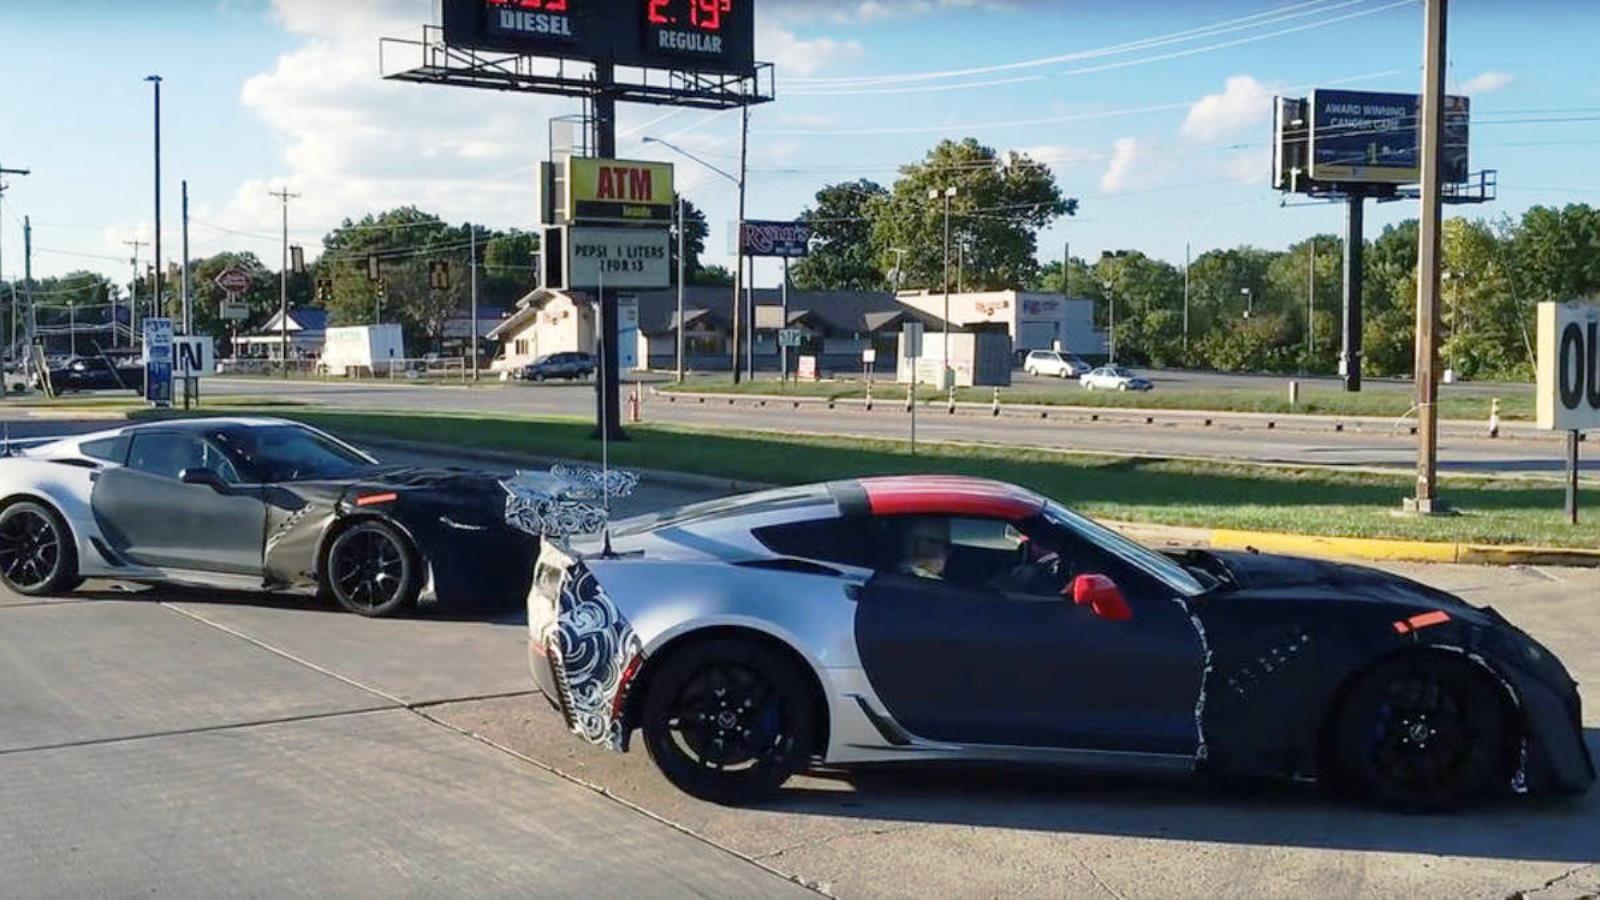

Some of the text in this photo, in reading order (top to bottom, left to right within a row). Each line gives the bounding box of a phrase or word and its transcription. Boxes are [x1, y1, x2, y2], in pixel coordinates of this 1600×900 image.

[500, 10, 572, 35] DIESEL
[658, 29, 722, 53] REGULAR
[1324, 104, 1406, 117] AWARD WINNING
[597, 166, 653, 201] ATM
[575, 244, 607, 258] PEPSI
[627, 245, 665, 258] LITERS
[173, 343, 202, 370] IN
